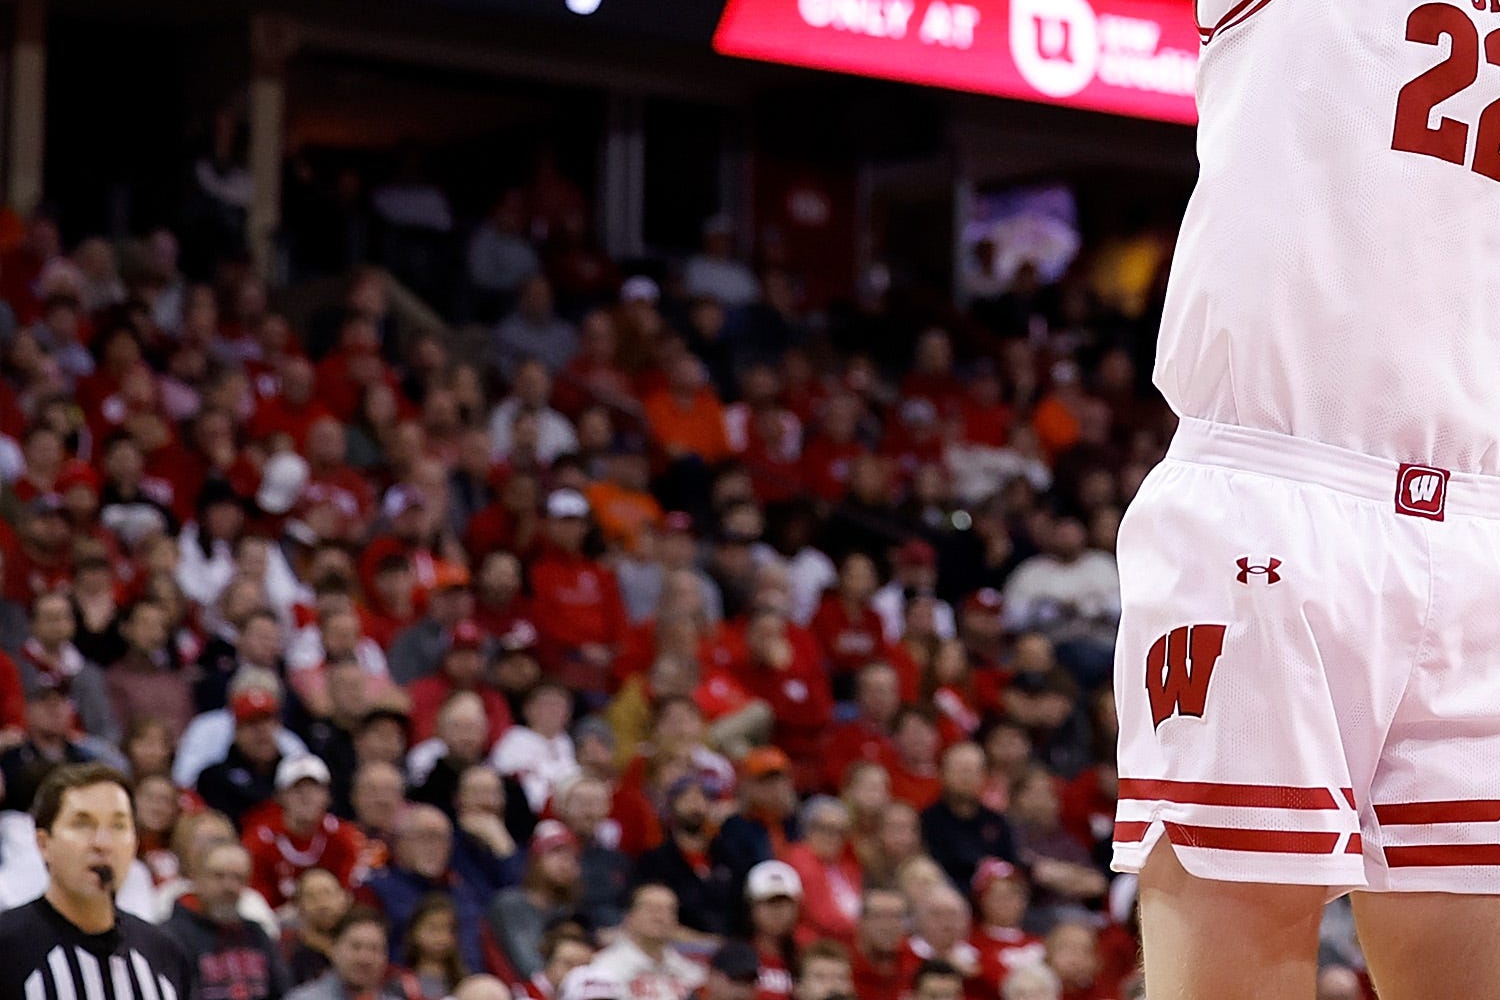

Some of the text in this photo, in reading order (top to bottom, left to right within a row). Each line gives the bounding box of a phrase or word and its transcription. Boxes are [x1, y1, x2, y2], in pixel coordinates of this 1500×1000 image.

[919, 1, 981, 50] AT
[1408, 474, 1440, 504] W
[1145, 623, 1227, 737] W
